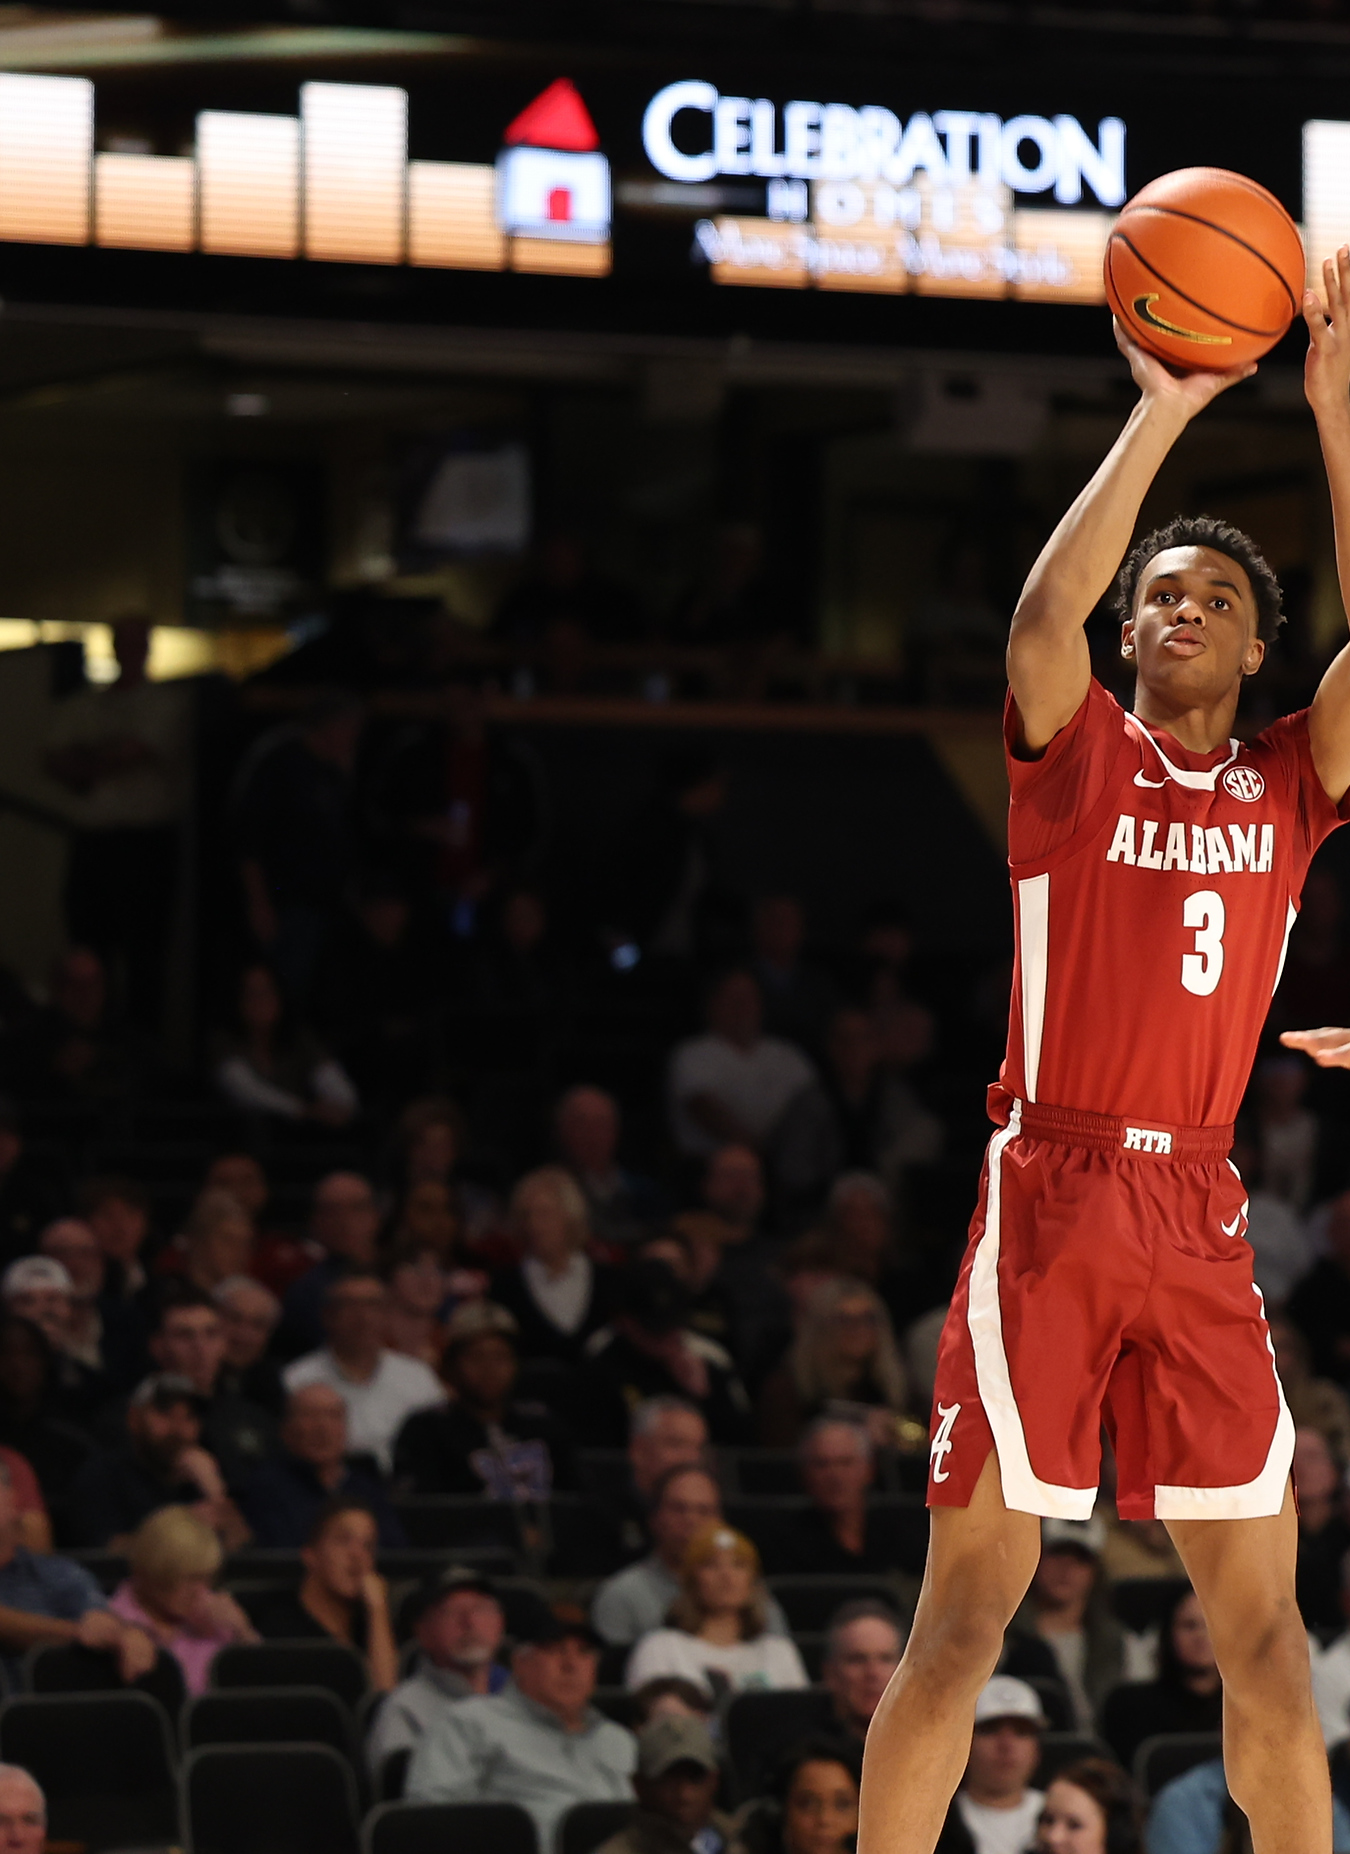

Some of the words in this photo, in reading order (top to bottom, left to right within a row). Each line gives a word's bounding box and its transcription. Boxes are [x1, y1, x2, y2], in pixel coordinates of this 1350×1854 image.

[643, 80, 1127, 206] CELEBRATION
[1227, 769, 1261, 799] SEC
[1106, 814, 1274, 874] ALABAMA
[1181, 890, 1225, 997] 3
[1123, 1126, 1172, 1155] RTR
